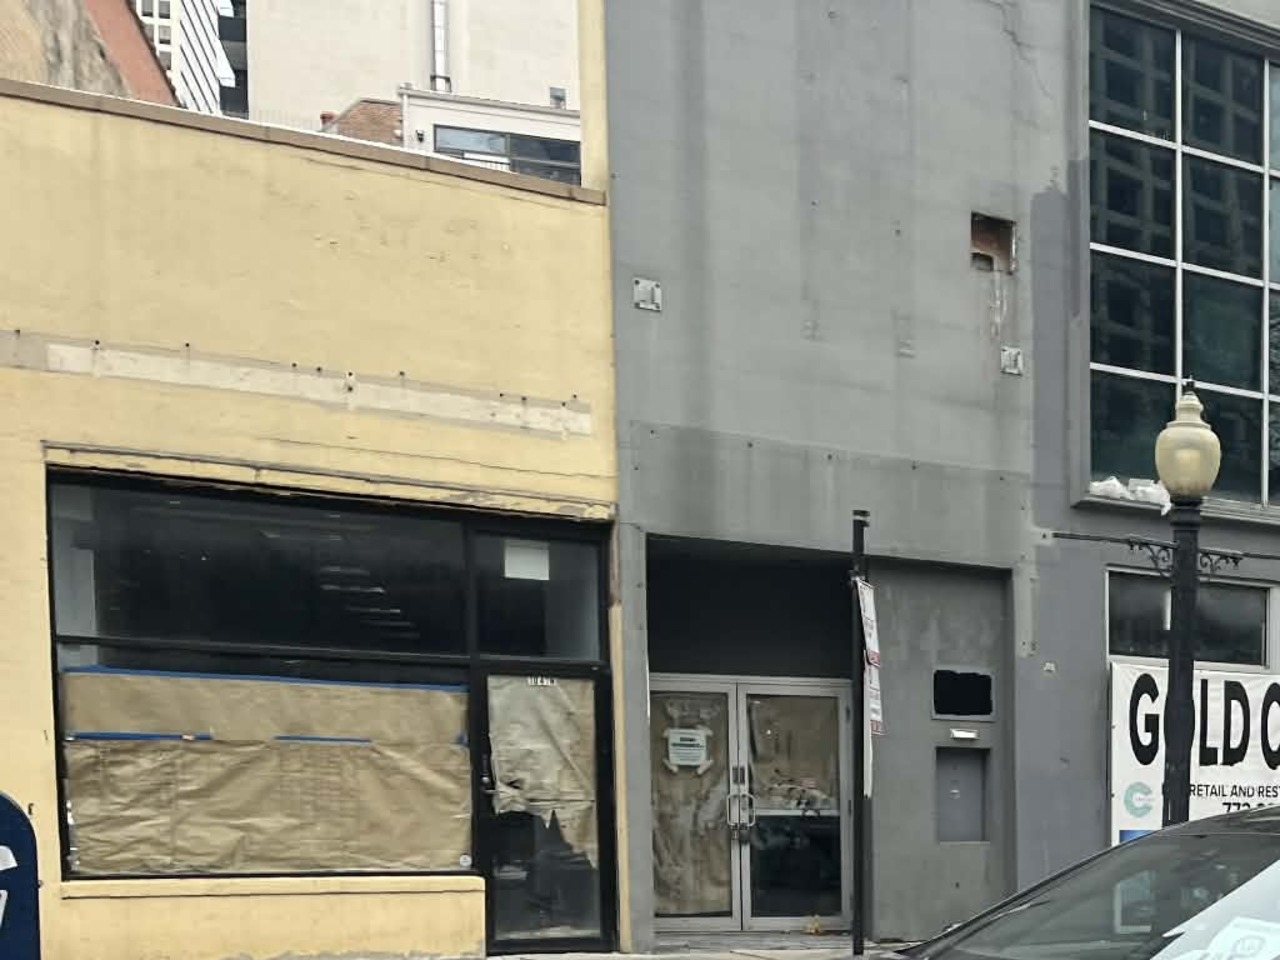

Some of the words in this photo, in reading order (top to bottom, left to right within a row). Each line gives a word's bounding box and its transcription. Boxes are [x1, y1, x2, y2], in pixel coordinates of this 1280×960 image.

[1129, 672, 1251, 767] GLD
[1190, 784, 1227, 798] RETAIL
[1230, 784, 1255, 798] AND
